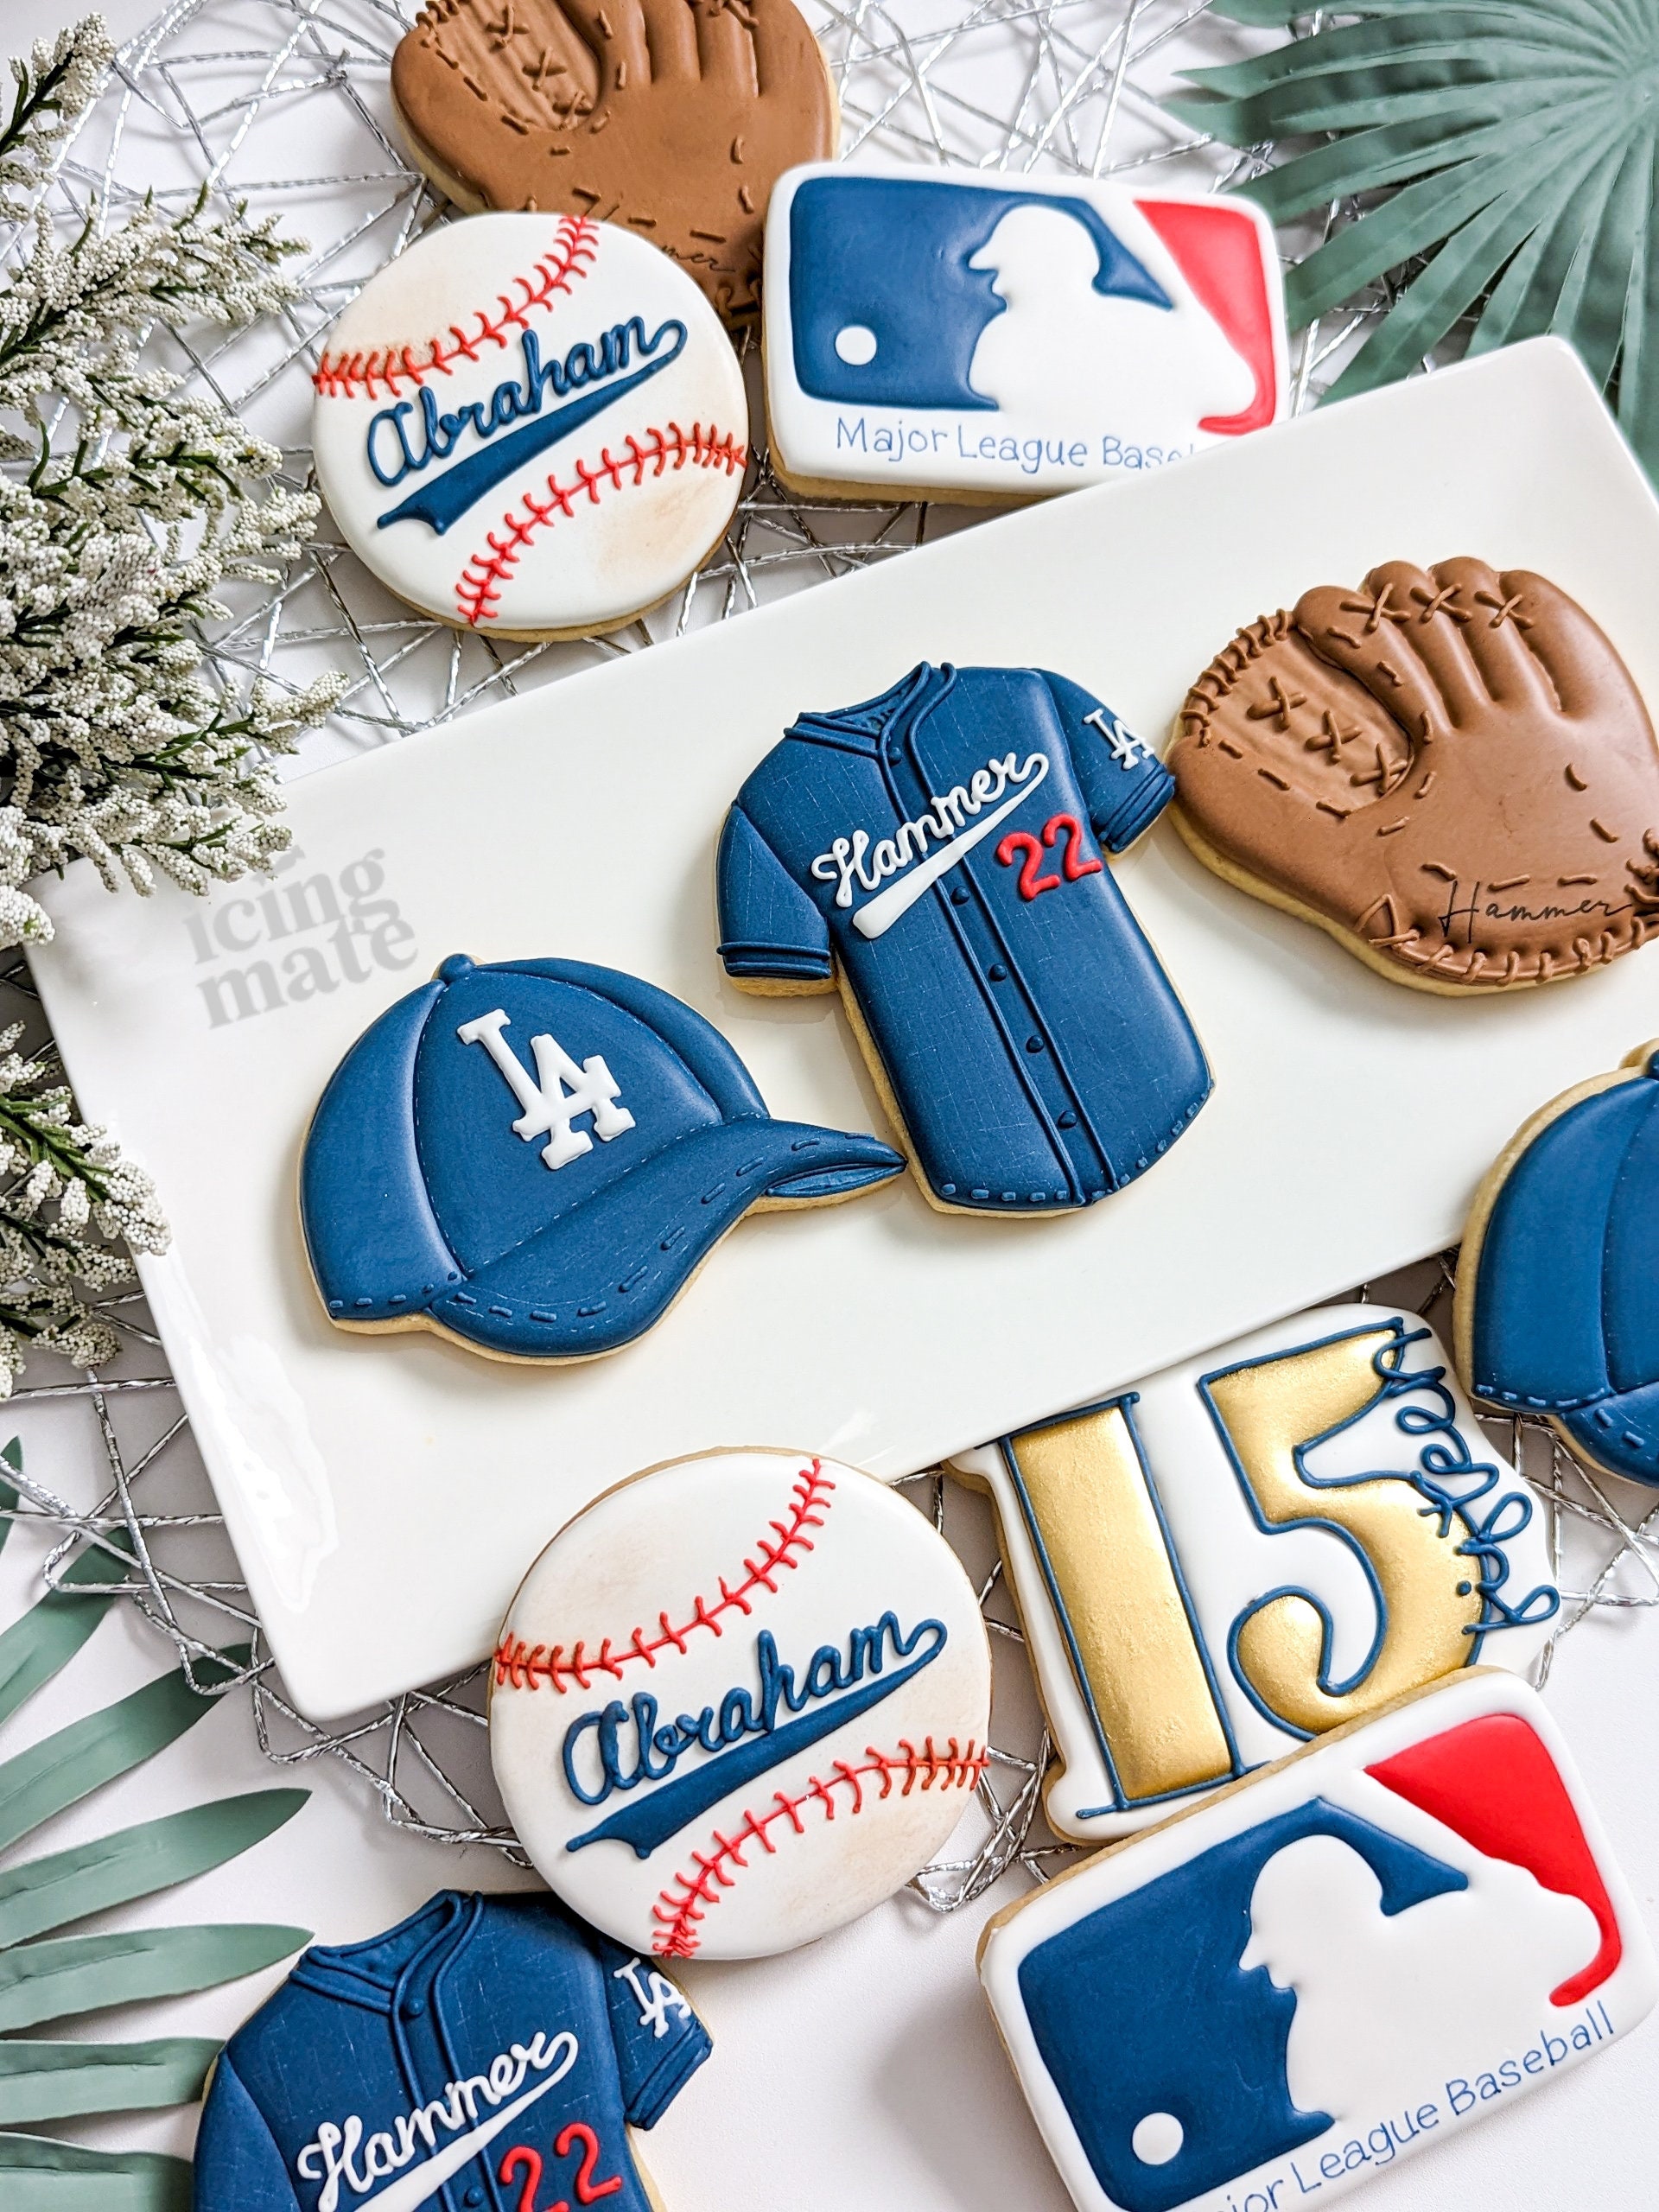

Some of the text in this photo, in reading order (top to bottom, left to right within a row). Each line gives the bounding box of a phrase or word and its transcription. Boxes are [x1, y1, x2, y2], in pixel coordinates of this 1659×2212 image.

[367, 315, 688, 486] Abraham
[836, 416, 1193, 474] Major League Base
[1084, 709, 1156, 770] LA
[810, 752, 1049, 907] Hammer
[996, 813, 1103, 901] 22
[1438, 880, 1632, 944] Hammer
[457, 1008, 636, 1170] LA
[975, 1317, 1486, 1818] 15
[562, 1610, 948, 1806] Abraham
[613, 1956, 693, 2039] LA
[297, 2031, 579, 2212] Hammer
[499, 2121, 623, 2212] 22
[1290, 2102, 1440, 2195] League
[1445, 1999, 1615, 2116] Baseball
